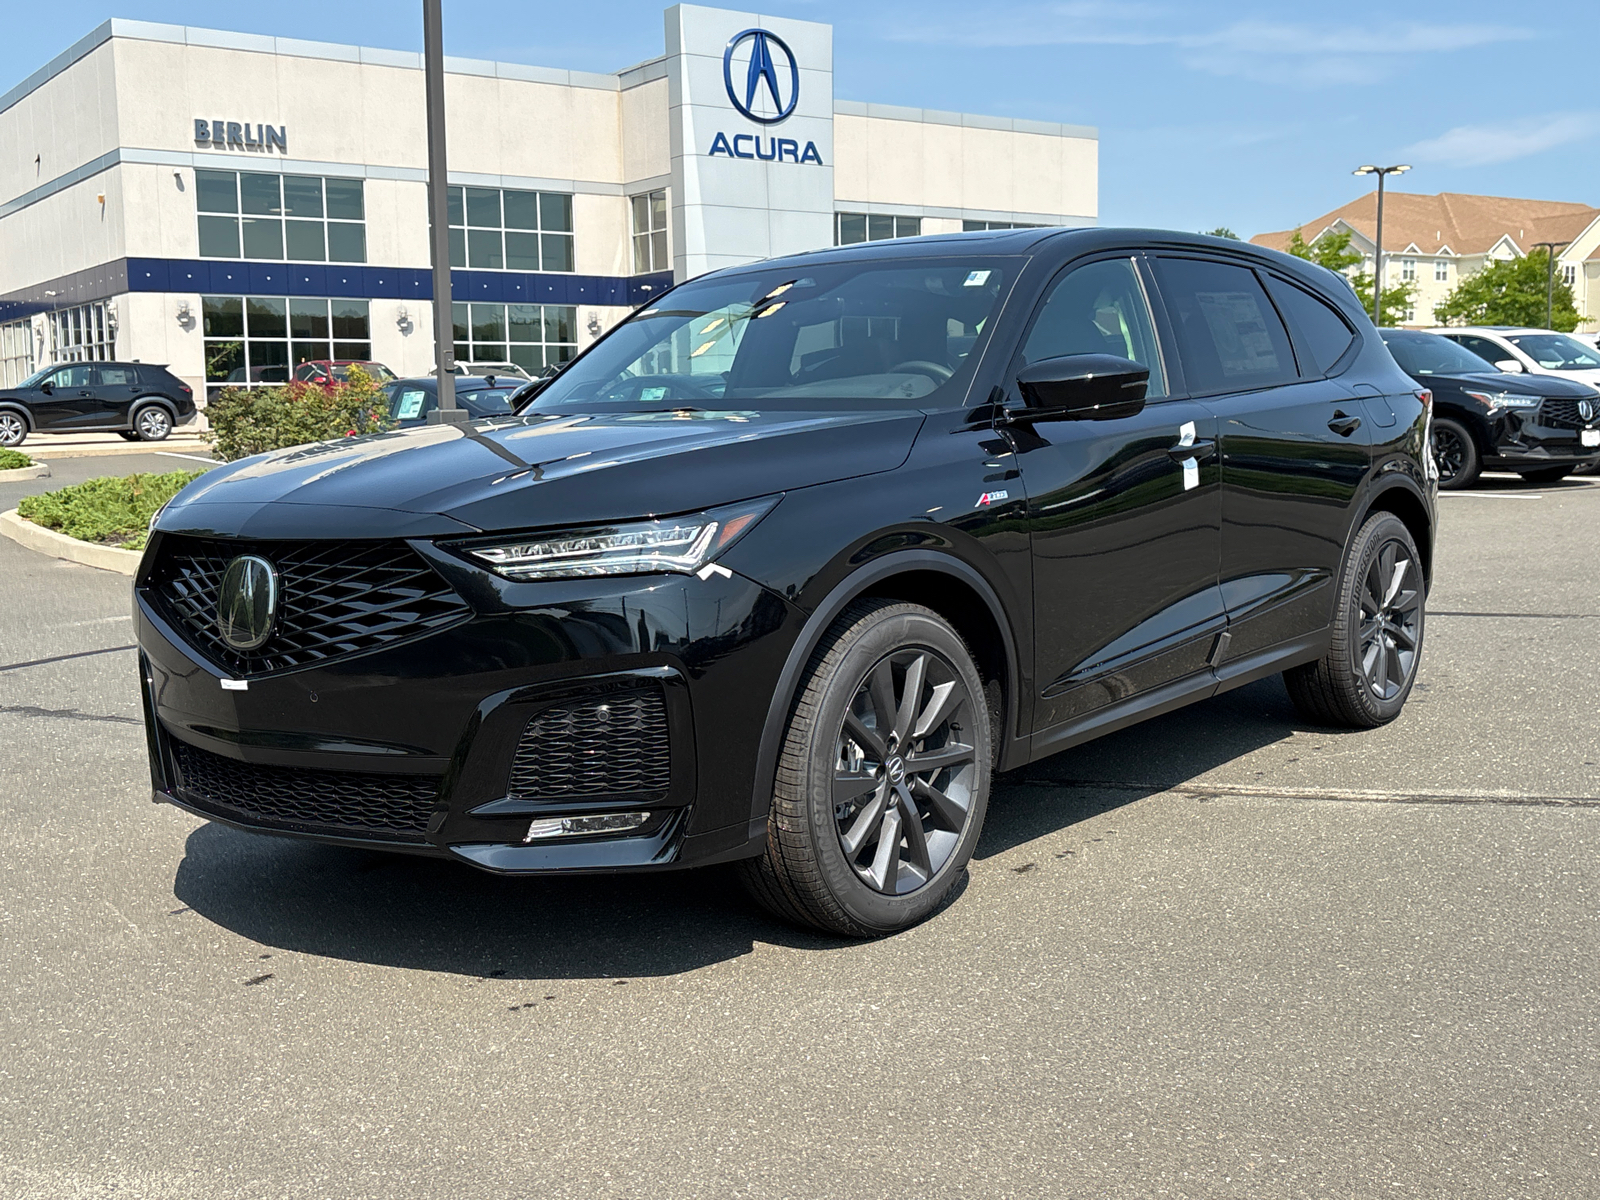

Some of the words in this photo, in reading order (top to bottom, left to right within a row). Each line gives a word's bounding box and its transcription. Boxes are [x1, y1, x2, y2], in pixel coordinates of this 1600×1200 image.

[194, 118, 287, 149] BERLIN
[708, 132, 823, 166] ACURA
[1353, 531, 1381, 608] BRIDGESTONE
[1356, 678, 1377, 714] ALENZA
[813, 757, 852, 896] BRIDGESTONE
